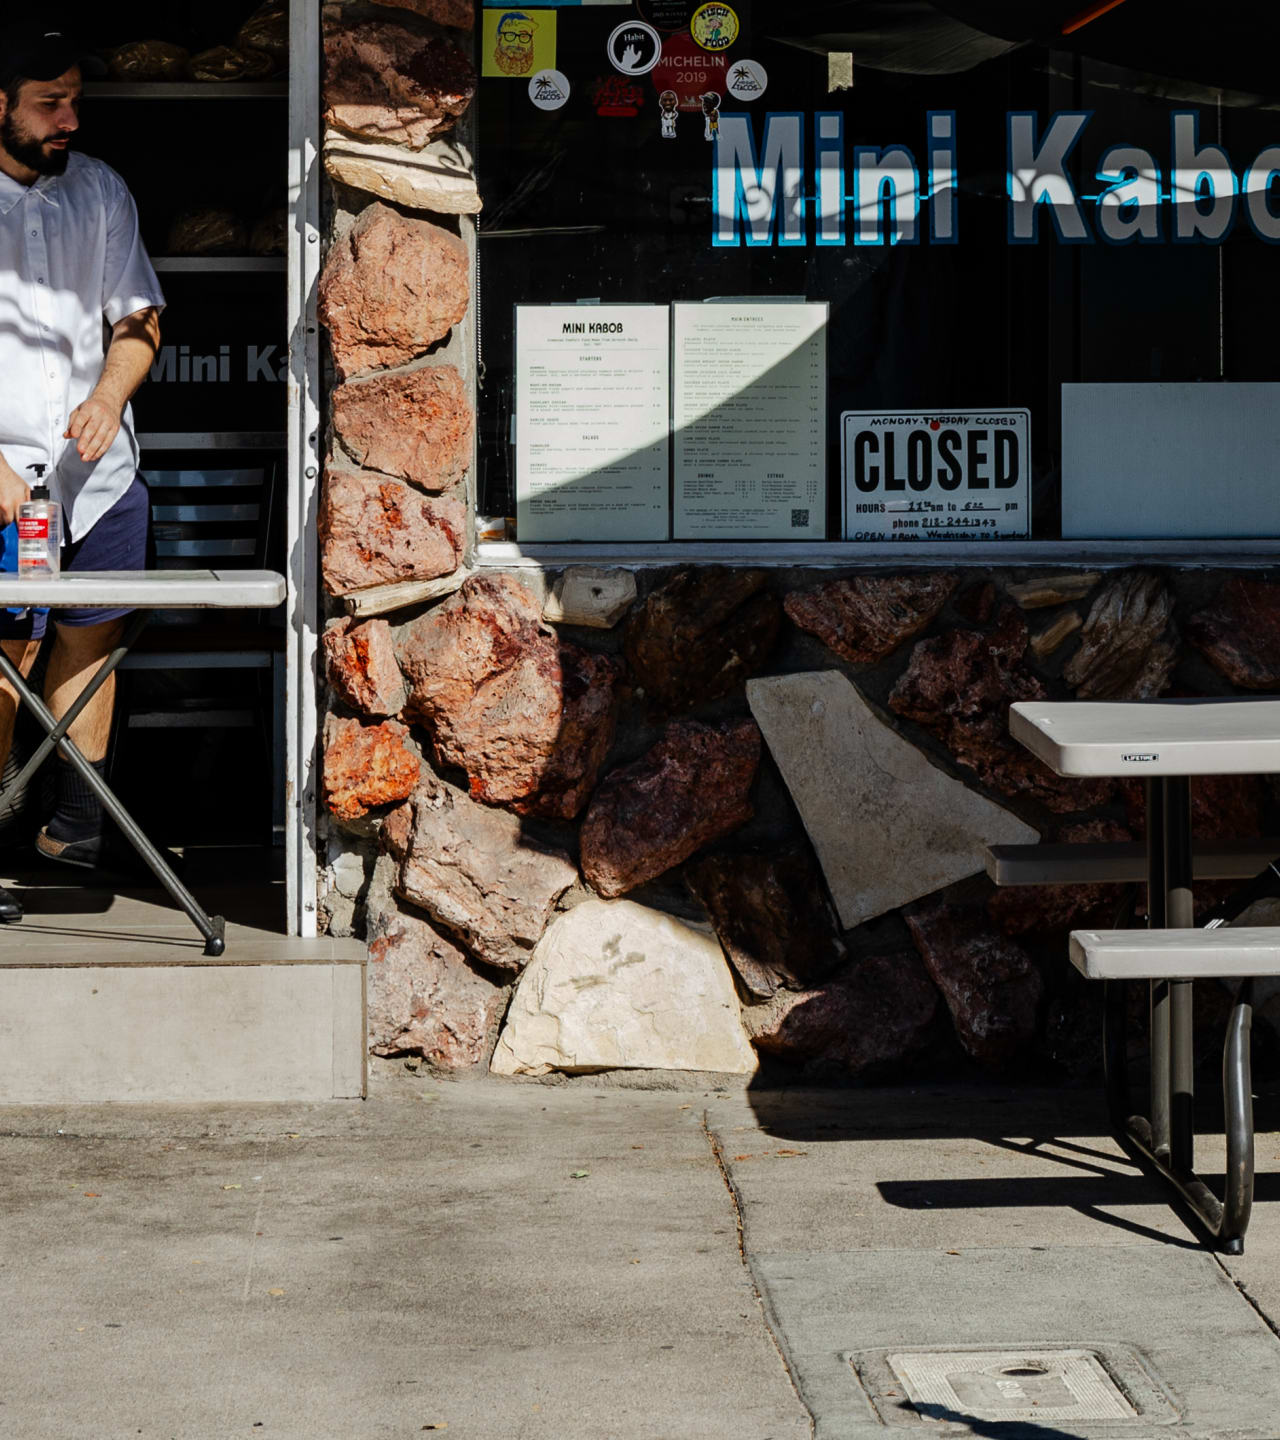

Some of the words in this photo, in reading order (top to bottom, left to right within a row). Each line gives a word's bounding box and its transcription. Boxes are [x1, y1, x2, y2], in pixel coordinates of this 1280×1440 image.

[623, 33, 645, 42] Habit
[658, 56, 725, 67] MICHELIN
[676, 72, 708, 83] 2019
[711, 110, 959, 247] Mini
[562, 323, 586, 334] MINI
[588, 323, 624, 334] KABOB
[145, 344, 231, 383] Mini
[975, 417, 1017, 426] CLOSED
[854, 429, 1019, 493] CLOSED
[855, 503, 886, 513] HOURS
[948, 501, 957, 512] to
[1005, 503, 1018, 512] pm
[893, 518, 919, 528] phone
[855, 532, 886, 541] OPEN
[891, 532, 920, 541] FROM
